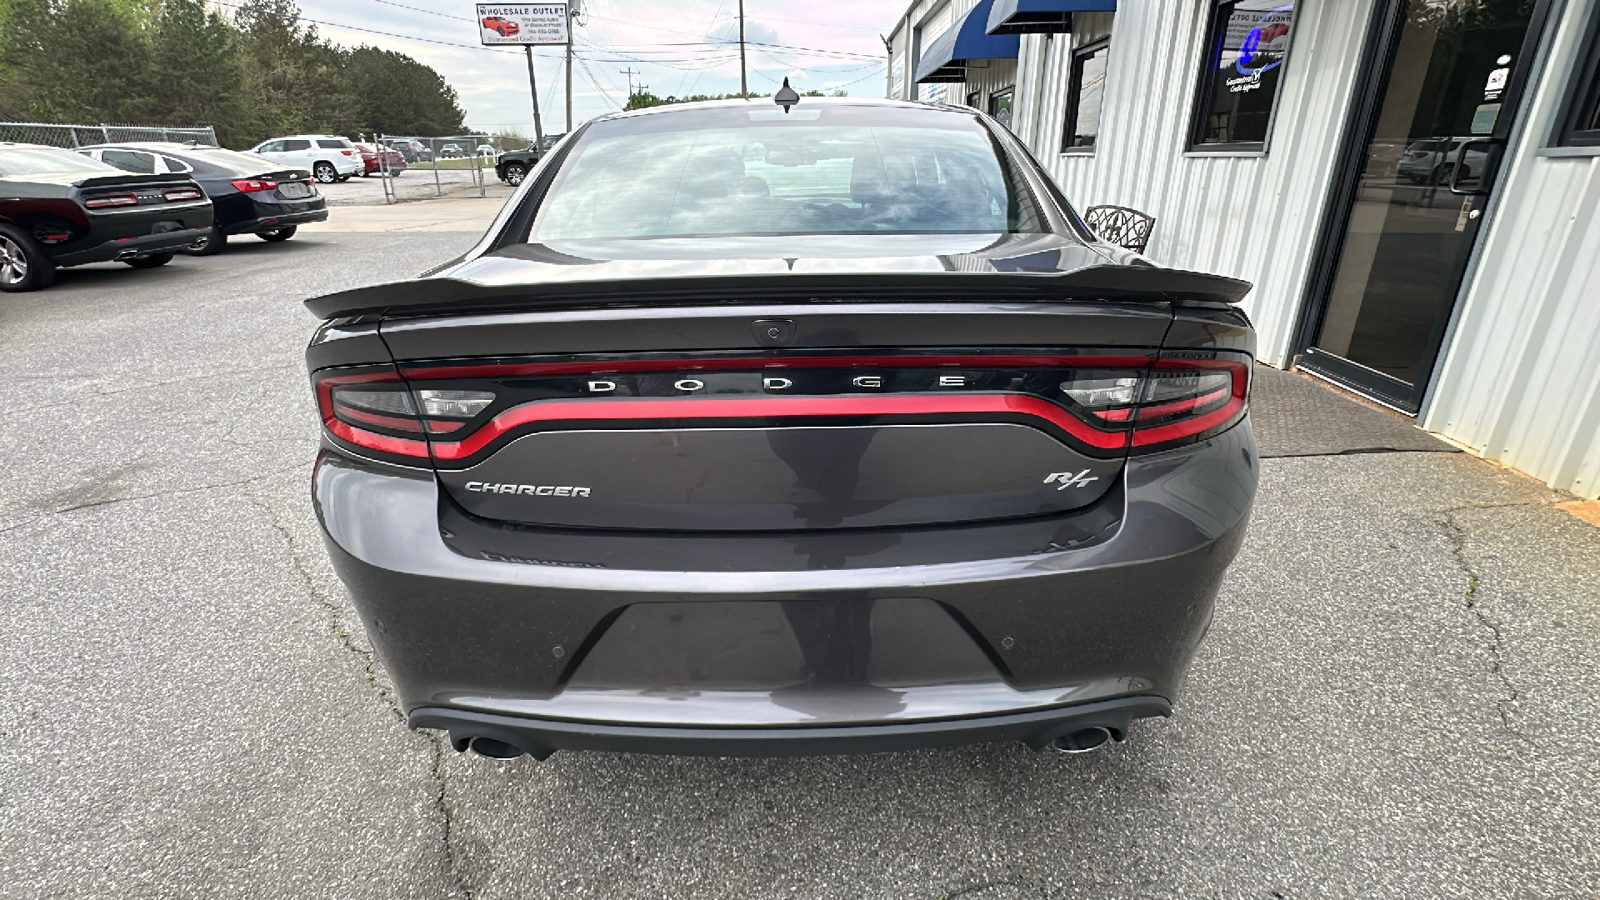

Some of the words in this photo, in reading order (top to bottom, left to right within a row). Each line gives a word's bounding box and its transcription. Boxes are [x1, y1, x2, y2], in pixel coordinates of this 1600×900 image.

[588, 376, 965, 392] DODGE
[1043, 468, 1099, 491] R/T
[464, 481, 591, 498] CHARGER
